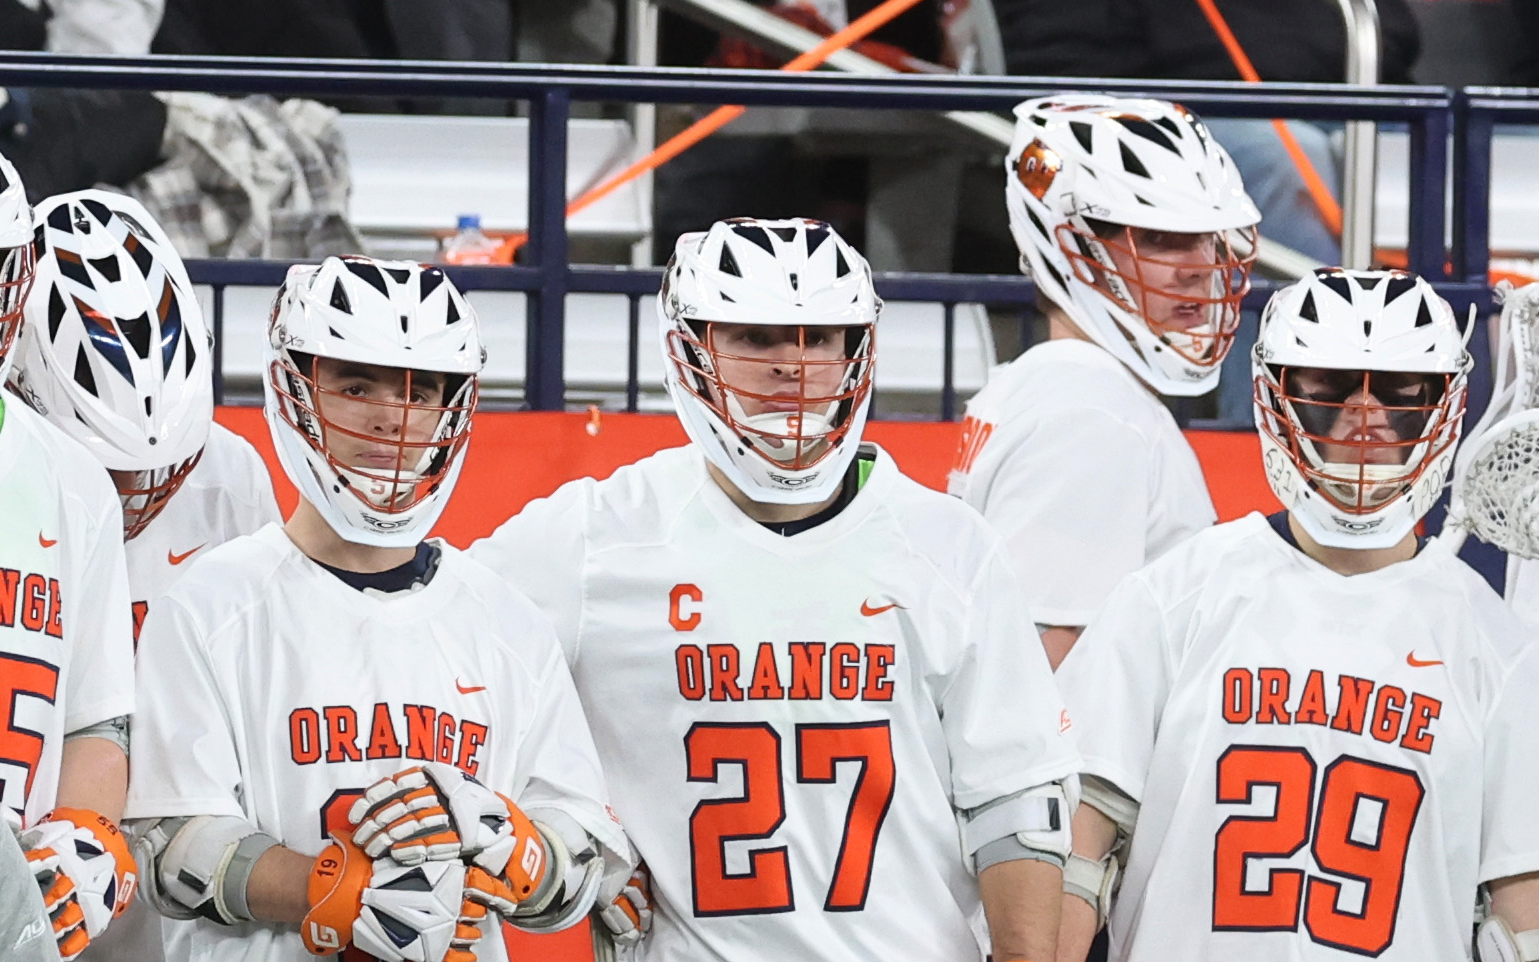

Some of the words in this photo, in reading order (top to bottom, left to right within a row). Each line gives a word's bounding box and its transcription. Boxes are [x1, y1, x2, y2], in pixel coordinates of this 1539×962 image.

[668, 583, 703, 632] C
[674, 641, 896, 702] ORANGE
[1221, 667, 1443, 755] ORANGE
[289, 702, 488, 776] ORANGE
[683, 719, 897, 918] 27
[1211, 743, 1426, 959] 29
